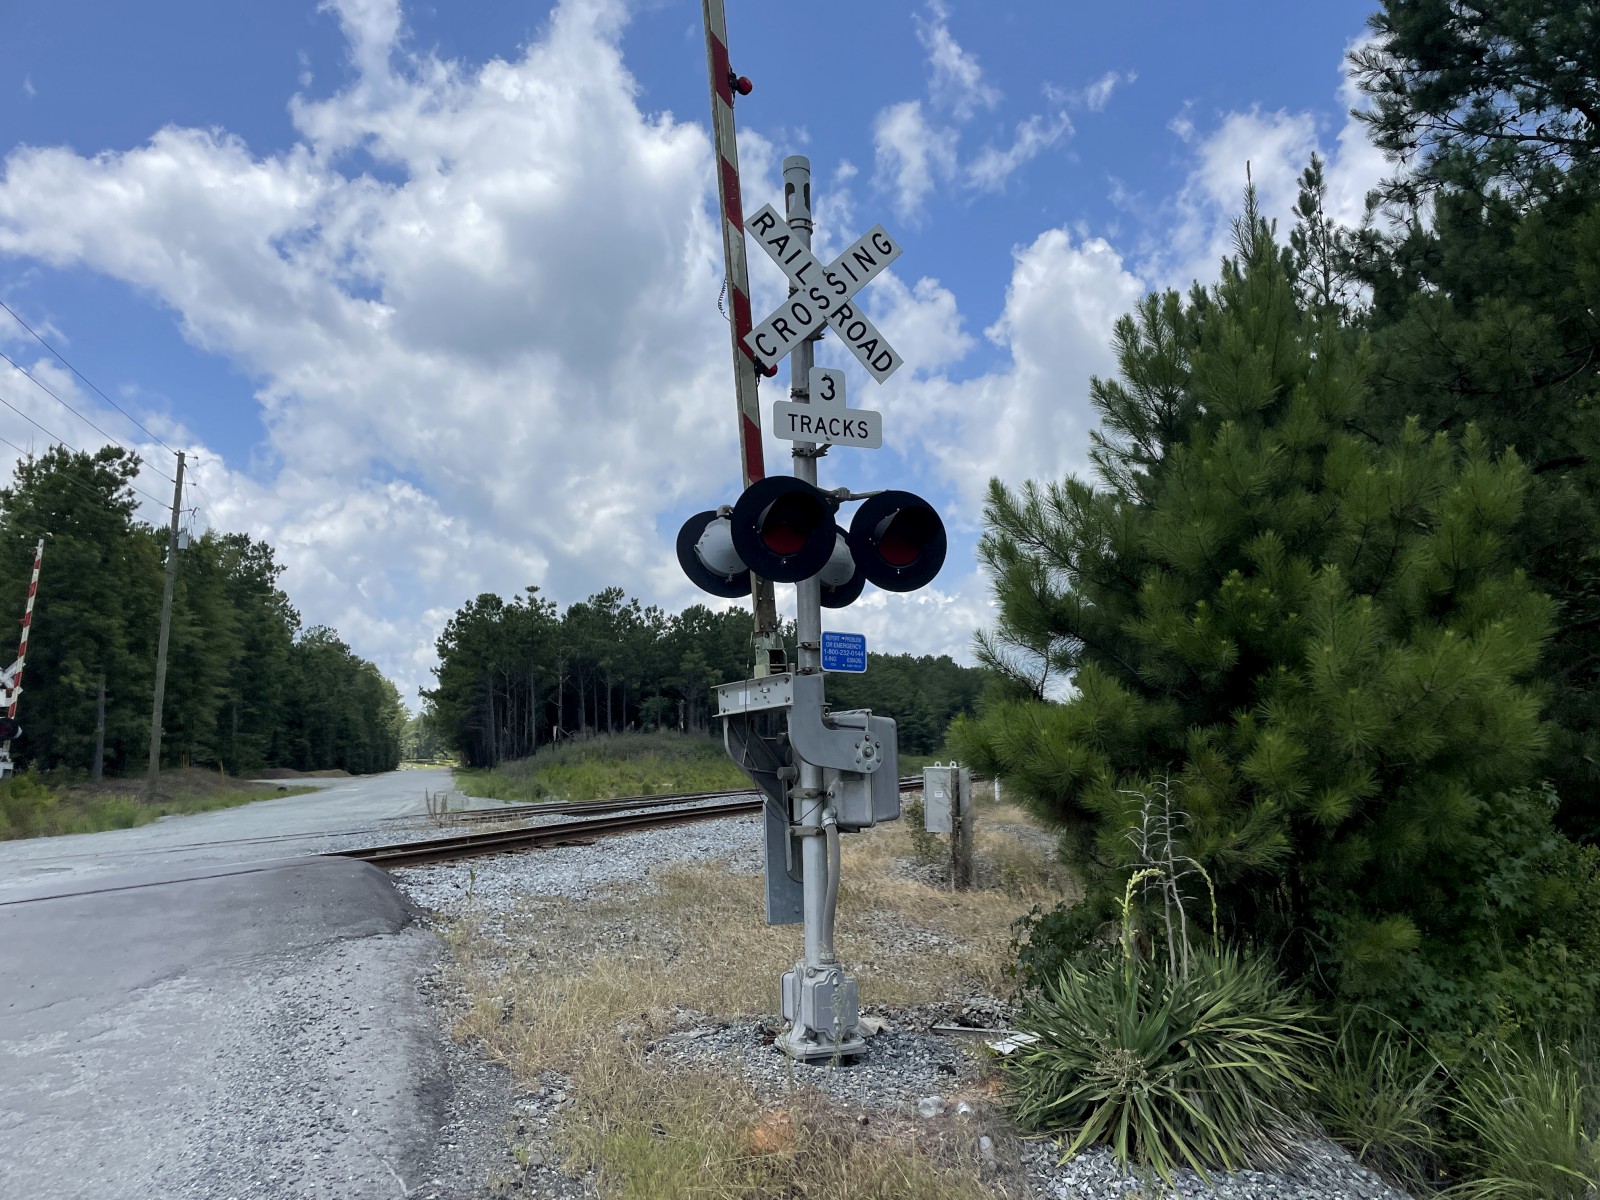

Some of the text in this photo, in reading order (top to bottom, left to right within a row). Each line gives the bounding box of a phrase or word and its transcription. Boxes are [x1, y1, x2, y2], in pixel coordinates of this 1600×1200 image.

[751, 211, 893, 372] RAIL ROAD
[755, 232, 892, 357] CROSSING
[787, 413, 869, 439] TRACKS
[820, 376, 836, 401] 3
